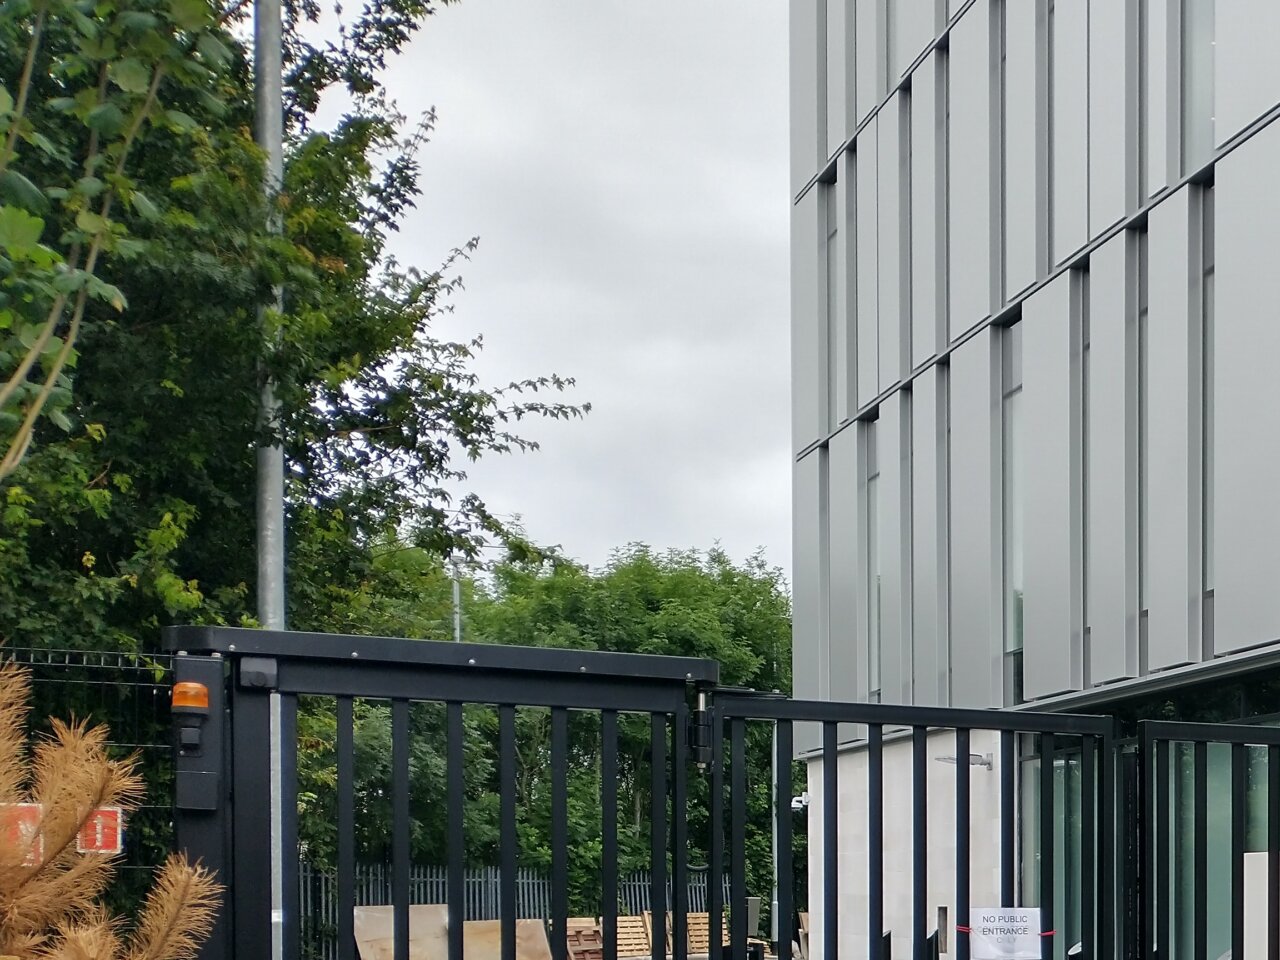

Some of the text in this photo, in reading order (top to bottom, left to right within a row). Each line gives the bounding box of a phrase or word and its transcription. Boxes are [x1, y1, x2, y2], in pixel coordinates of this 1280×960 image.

[982, 915, 1028, 923] NO PUBLIC
[982, 927, 1029, 935] ENTRANCE
